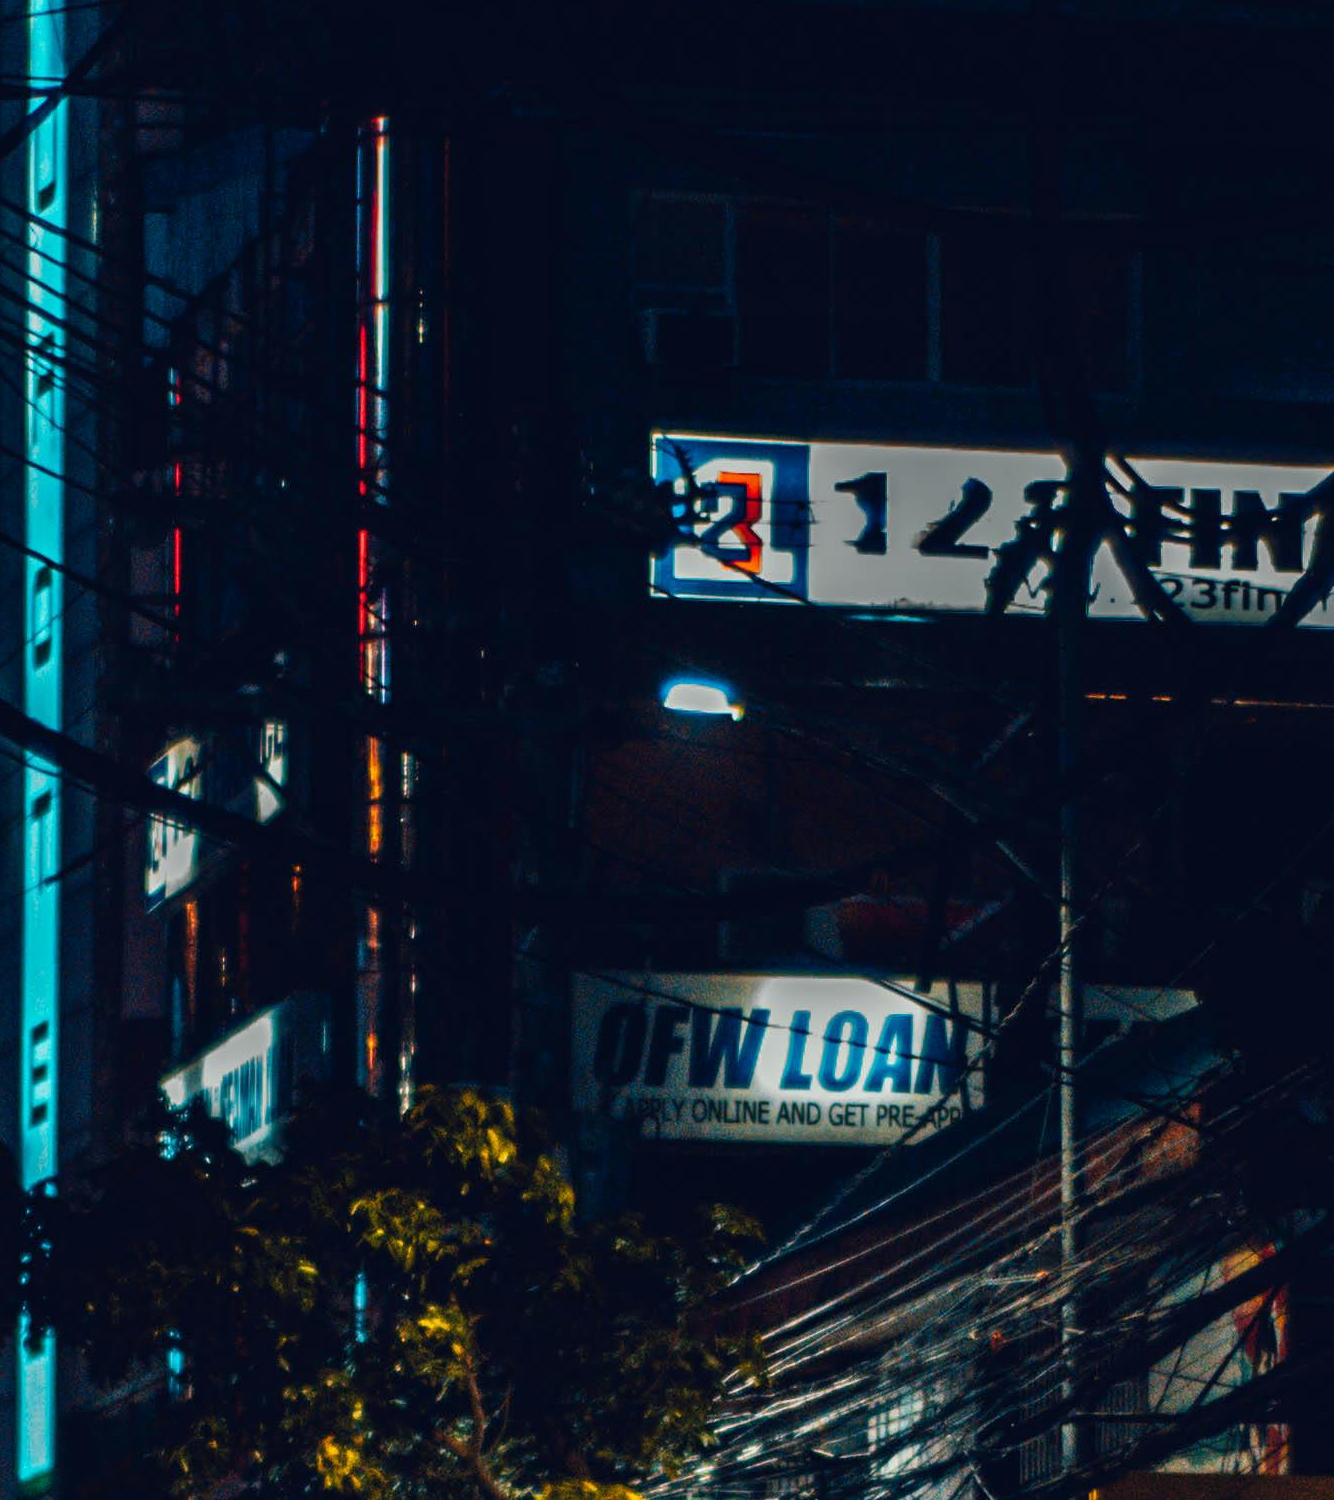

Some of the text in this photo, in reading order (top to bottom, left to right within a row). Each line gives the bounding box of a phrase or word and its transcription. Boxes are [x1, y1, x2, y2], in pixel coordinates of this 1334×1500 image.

[593, 1002, 771, 1088] OFW
[692, 1097, 771, 1126] ONLINE
[777, 1100, 822, 1126] AND
[827, 1101, 869, 1127] GET
